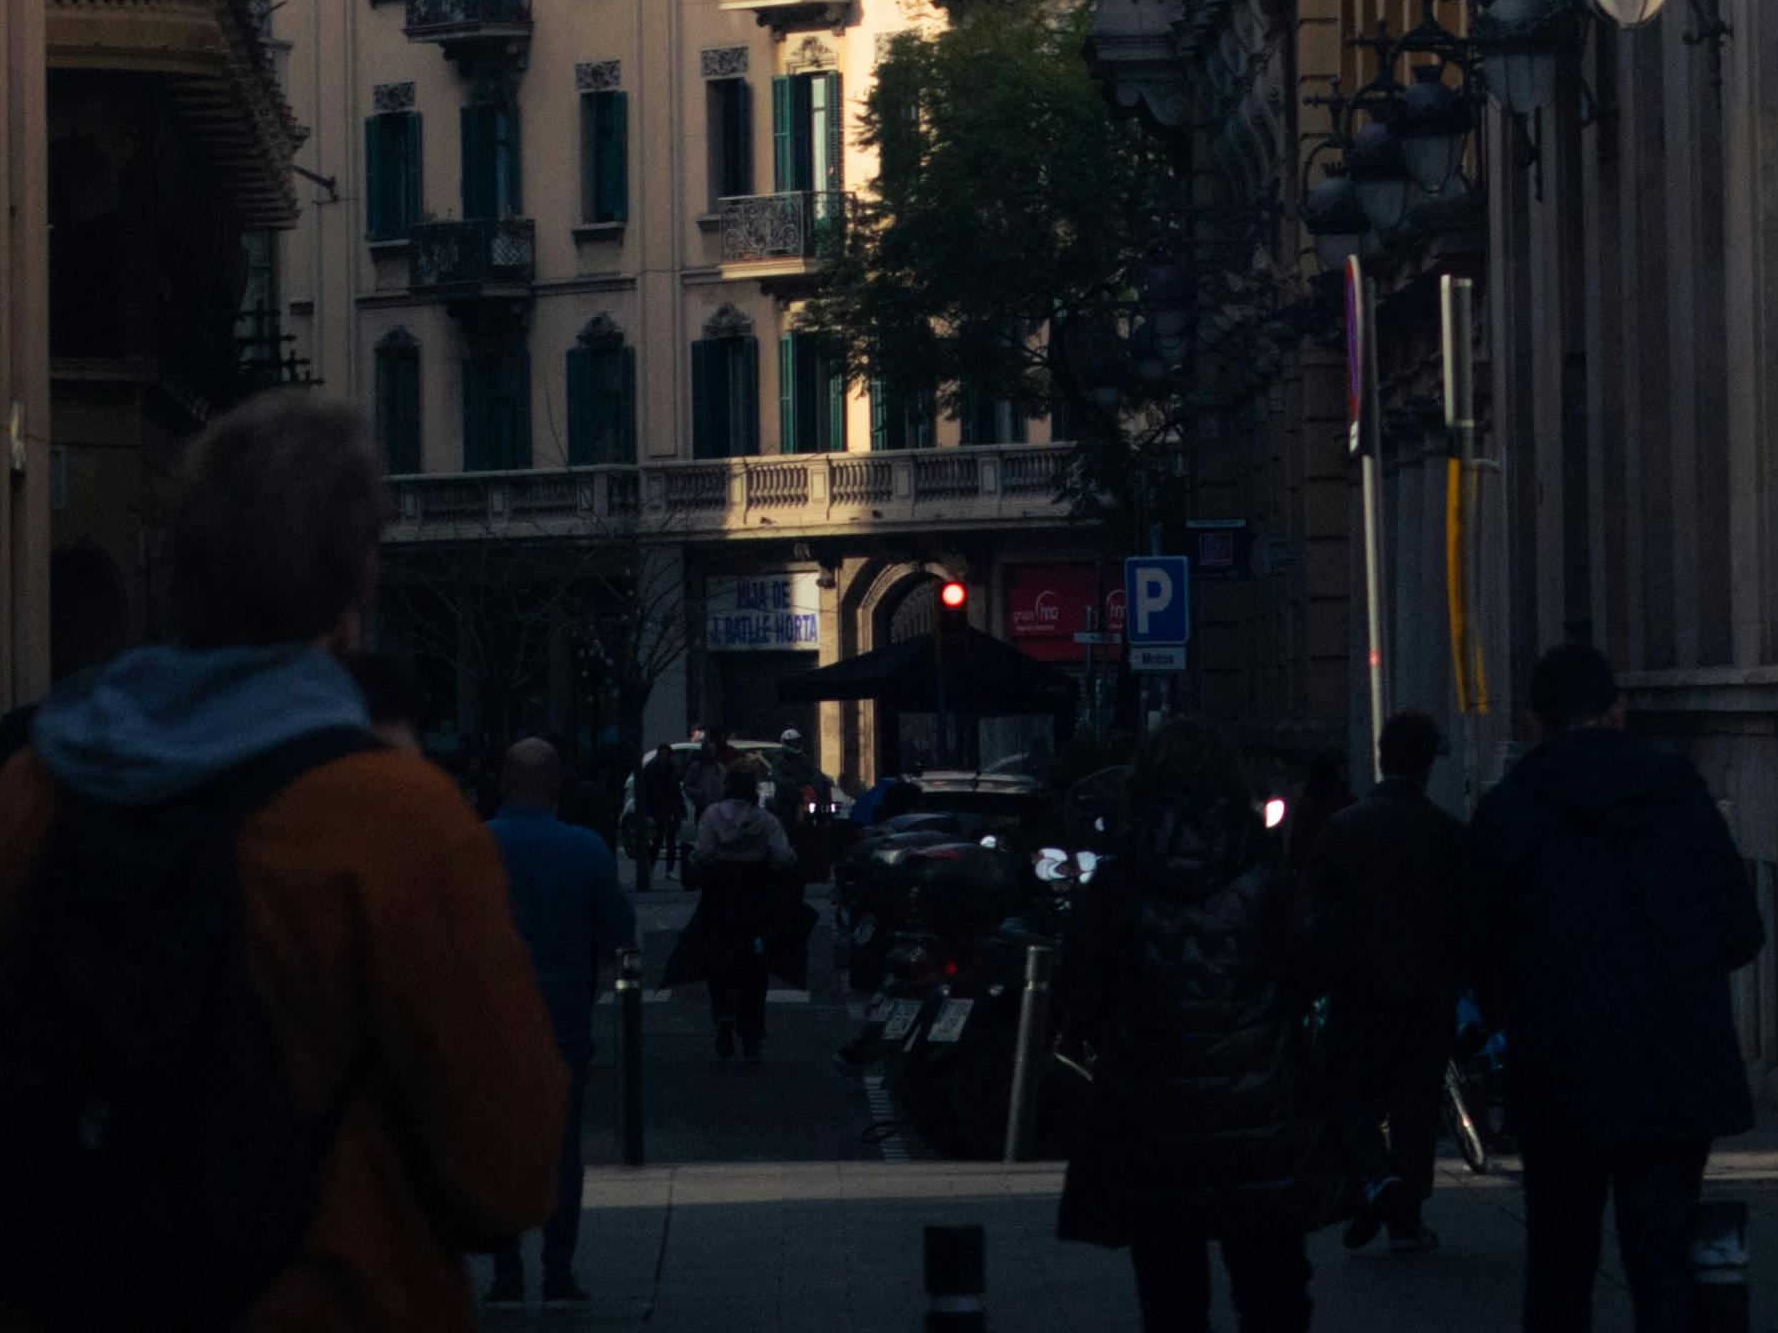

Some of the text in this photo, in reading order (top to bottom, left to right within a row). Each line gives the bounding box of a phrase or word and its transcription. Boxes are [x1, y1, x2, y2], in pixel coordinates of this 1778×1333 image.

[736, 581, 790, 610] HIJA DE
[1134, 567, 1173, 634] P
[725, 616, 770, 644] BATLLE
[775, 614, 818, 643] HORTA
